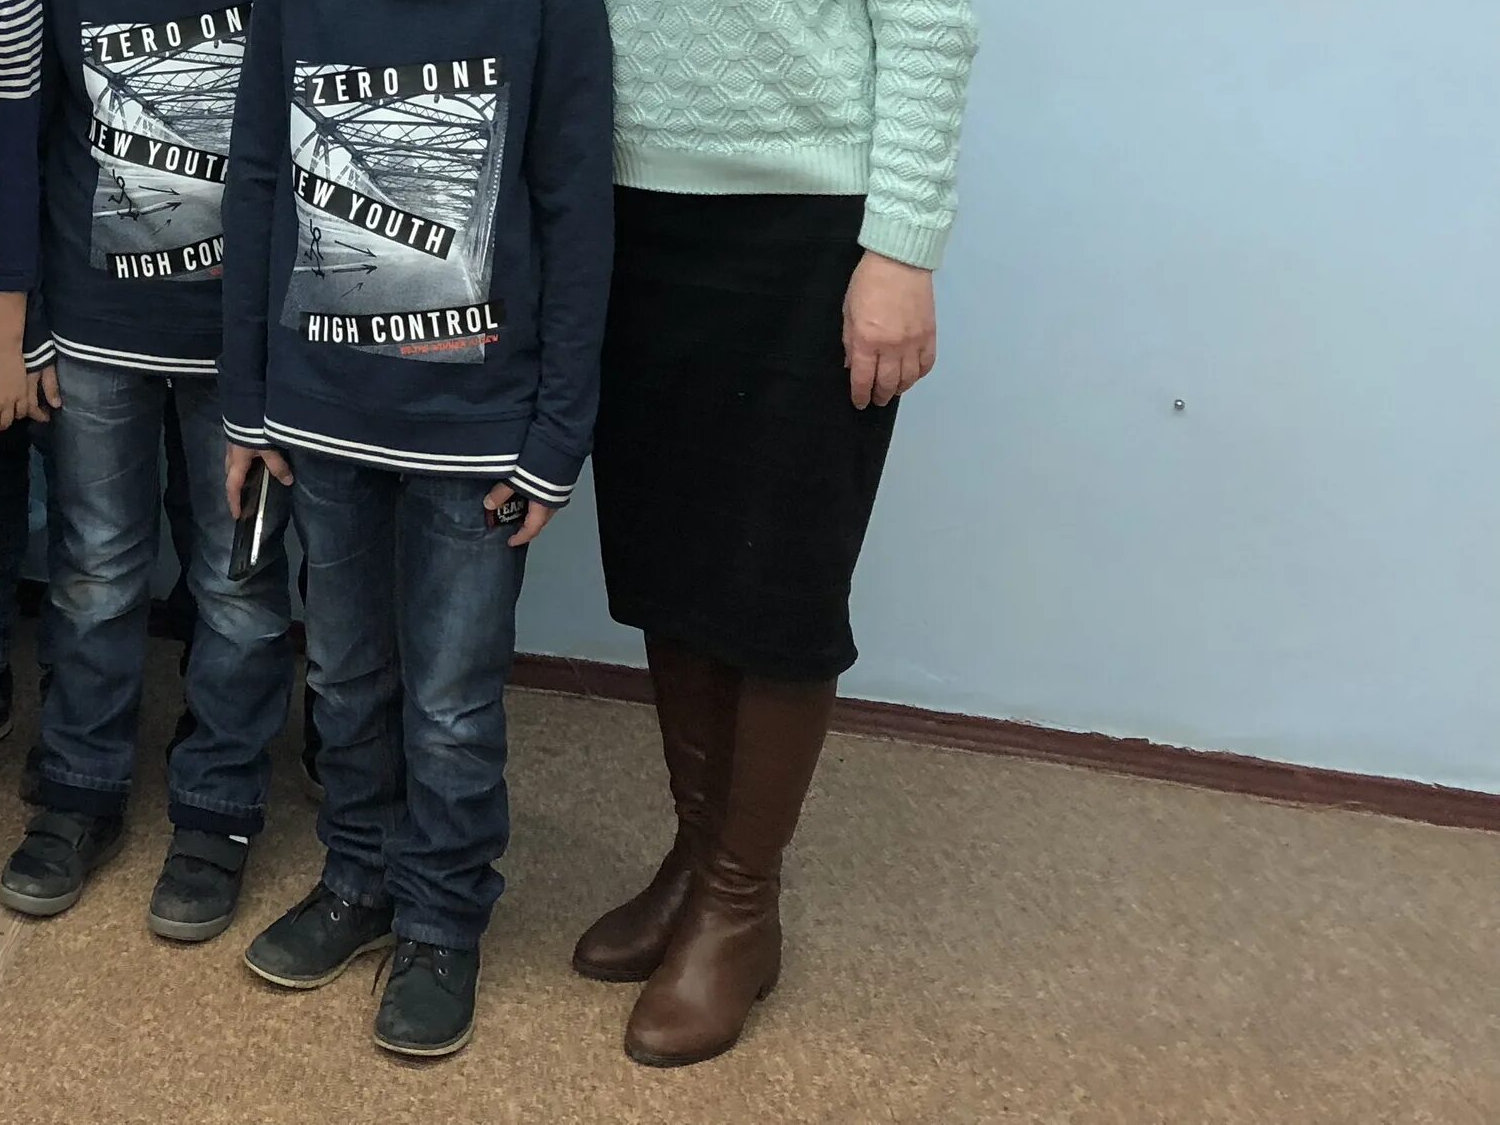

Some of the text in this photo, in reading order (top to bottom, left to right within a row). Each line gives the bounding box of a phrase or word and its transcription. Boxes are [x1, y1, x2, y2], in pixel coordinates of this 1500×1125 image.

[96, 4, 250, 63] ZERO ON
[311, 57, 498, 105] ZERO ONE
[348, 193, 447, 254] YOUTH
[115, 251, 172, 279] HIGH
[308, 304, 499, 344] HIGH CONTROL
